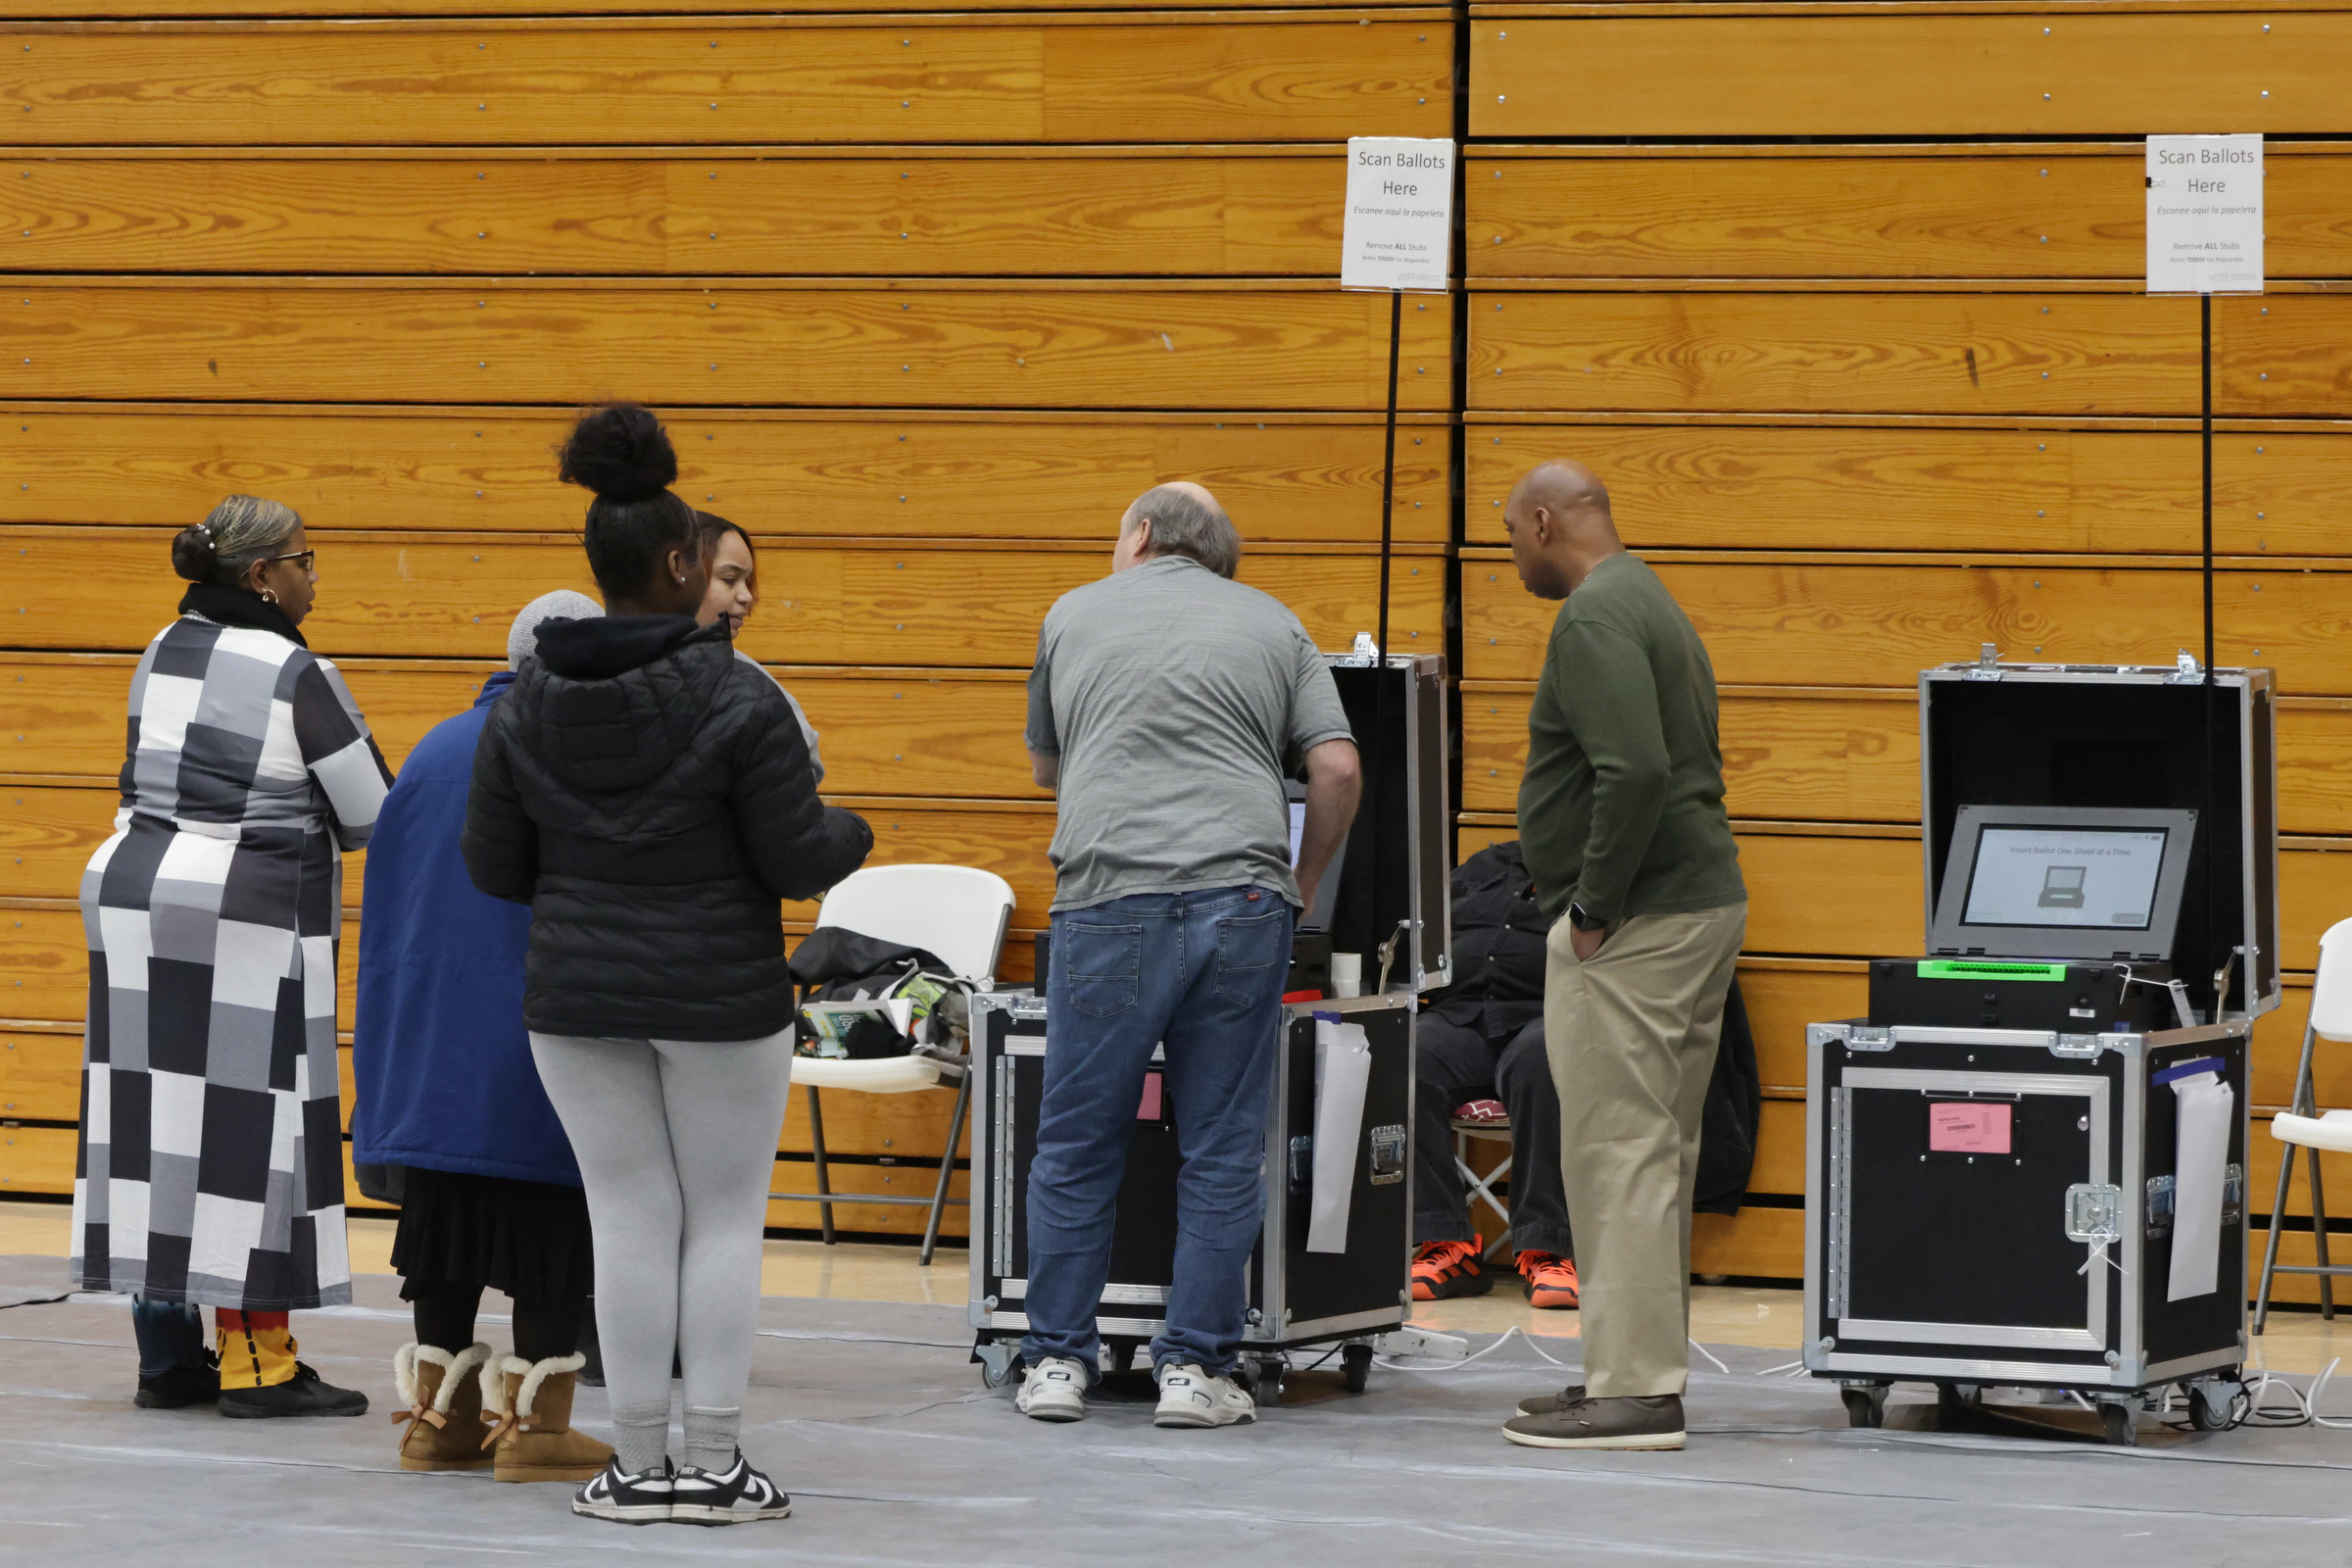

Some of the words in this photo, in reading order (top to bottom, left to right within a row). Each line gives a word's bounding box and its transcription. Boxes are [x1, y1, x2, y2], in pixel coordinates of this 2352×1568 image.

[1358, 151, 1392, 167] Scan
[1396, 153, 1446, 169] Ballots
[2159, 149, 2195, 165] Scan
[2201, 148, 2254, 164] Ballots
[1383, 180, 1418, 196] Here
[2187, 178, 2226, 193] Here
[1353, 206, 1383, 215] Escanee
[1385, 208, 1401, 217] aquí
[1411, 209, 1445, 218] papeleta
[2157, 206, 2189, 215] Escanee
[2191, 206, 2209, 216] aquí
[2221, 206, 2256, 216] papeleta
[2209, 273, 2230, 282] VOTE
[649, 1468, 665, 1477] NIKE
[680, 1466, 697, 1475] NIKE
